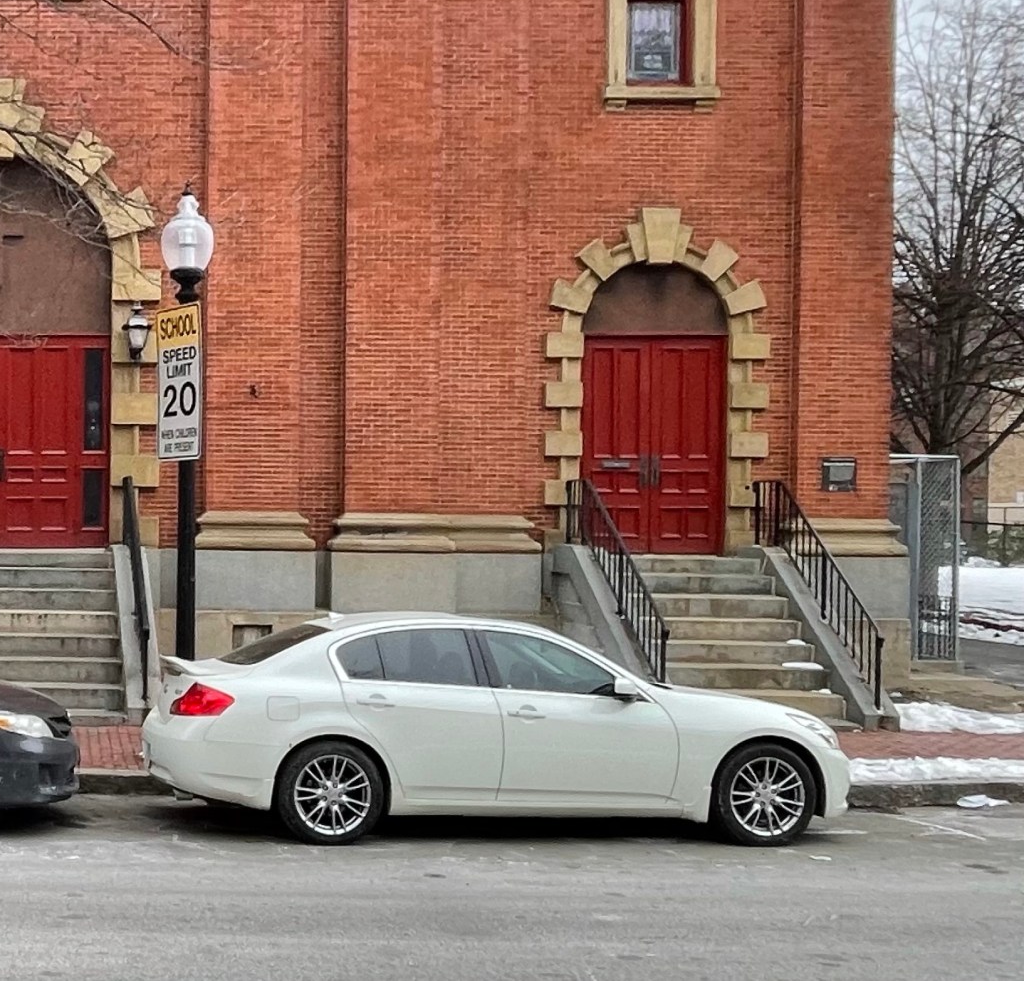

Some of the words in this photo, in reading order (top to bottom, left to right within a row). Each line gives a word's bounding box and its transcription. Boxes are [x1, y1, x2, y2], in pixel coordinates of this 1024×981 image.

[160, 314, 196, 340] SCHOOL
[163, 346, 196, 364] SPEED
[167, 363, 192, 379] LIMIT
[163, 381, 196, 418] 20
